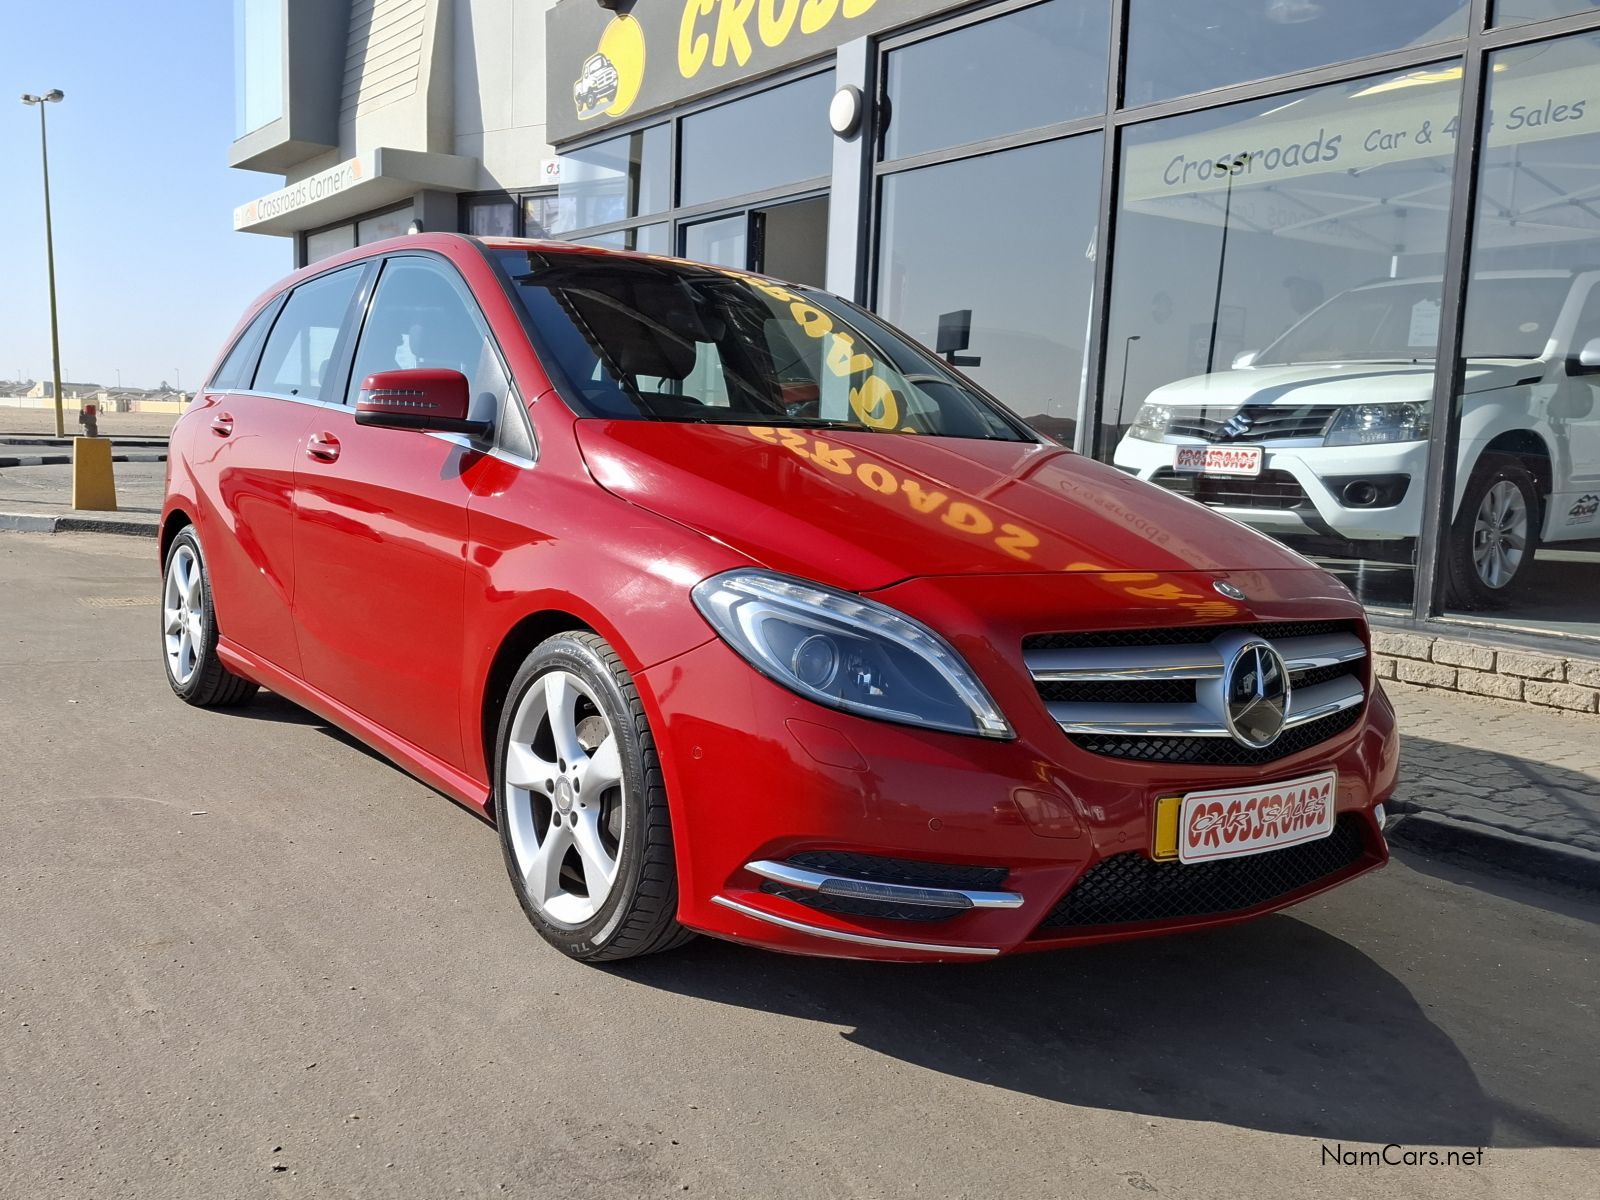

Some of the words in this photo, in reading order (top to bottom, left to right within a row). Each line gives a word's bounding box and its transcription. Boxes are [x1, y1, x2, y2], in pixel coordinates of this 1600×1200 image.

[1163, 128, 1342, 186] Crossroads
[1363, 129, 1406, 153] Car
[1414, 120, 1432, 145] &
[1505, 99, 1586, 130] Sales
[257, 186, 306, 219] Crossroads
[309, 168, 345, 200] Corner
[1178, 449, 1257, 469] CROSSROADS
[1188, 783, 1330, 848] CROSSROADS
[1192, 811, 1250, 833] CAR
[1261, 796, 1327, 824] SALES
